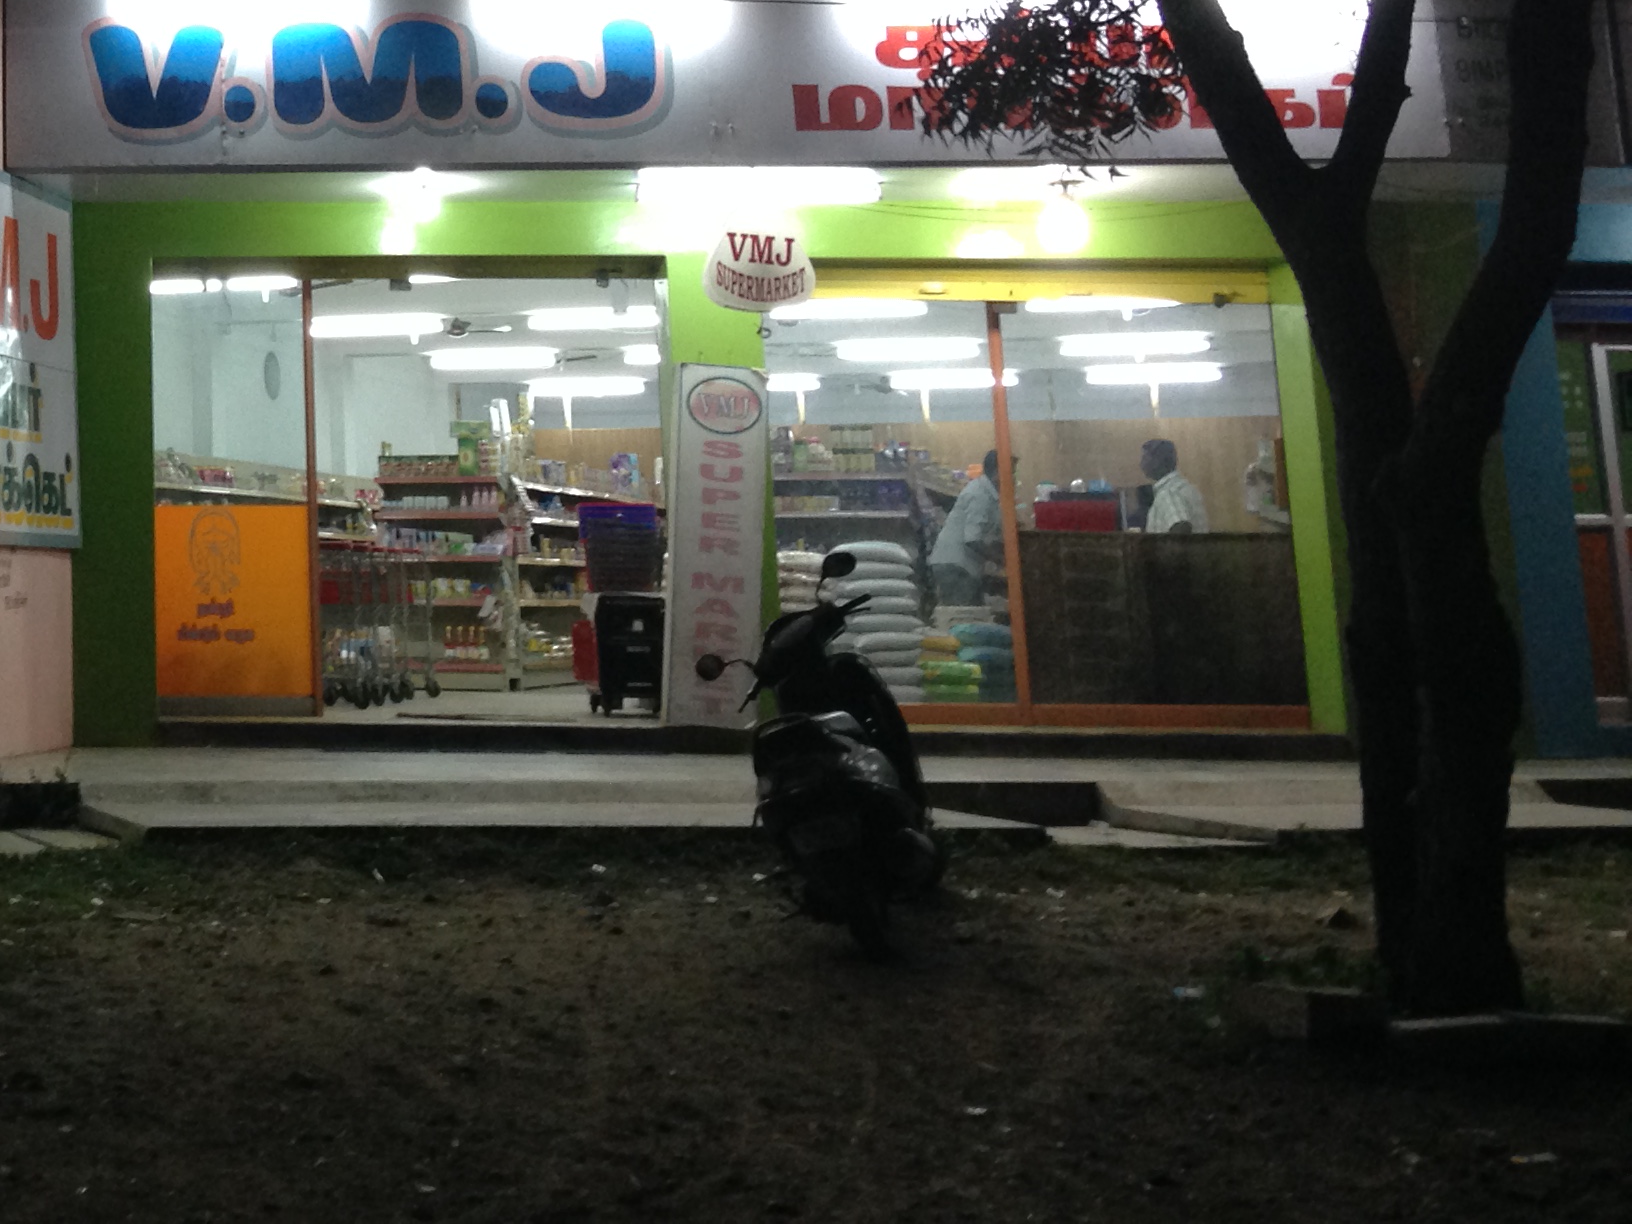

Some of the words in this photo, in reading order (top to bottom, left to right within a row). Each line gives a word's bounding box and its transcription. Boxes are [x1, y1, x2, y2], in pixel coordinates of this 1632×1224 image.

[81, 12, 666, 134] V.M.J
[716, 261, 805, 302] SUPERMARKET
[727, 232, 794, 266] VMJ
[691, 572, 745, 715] MART
